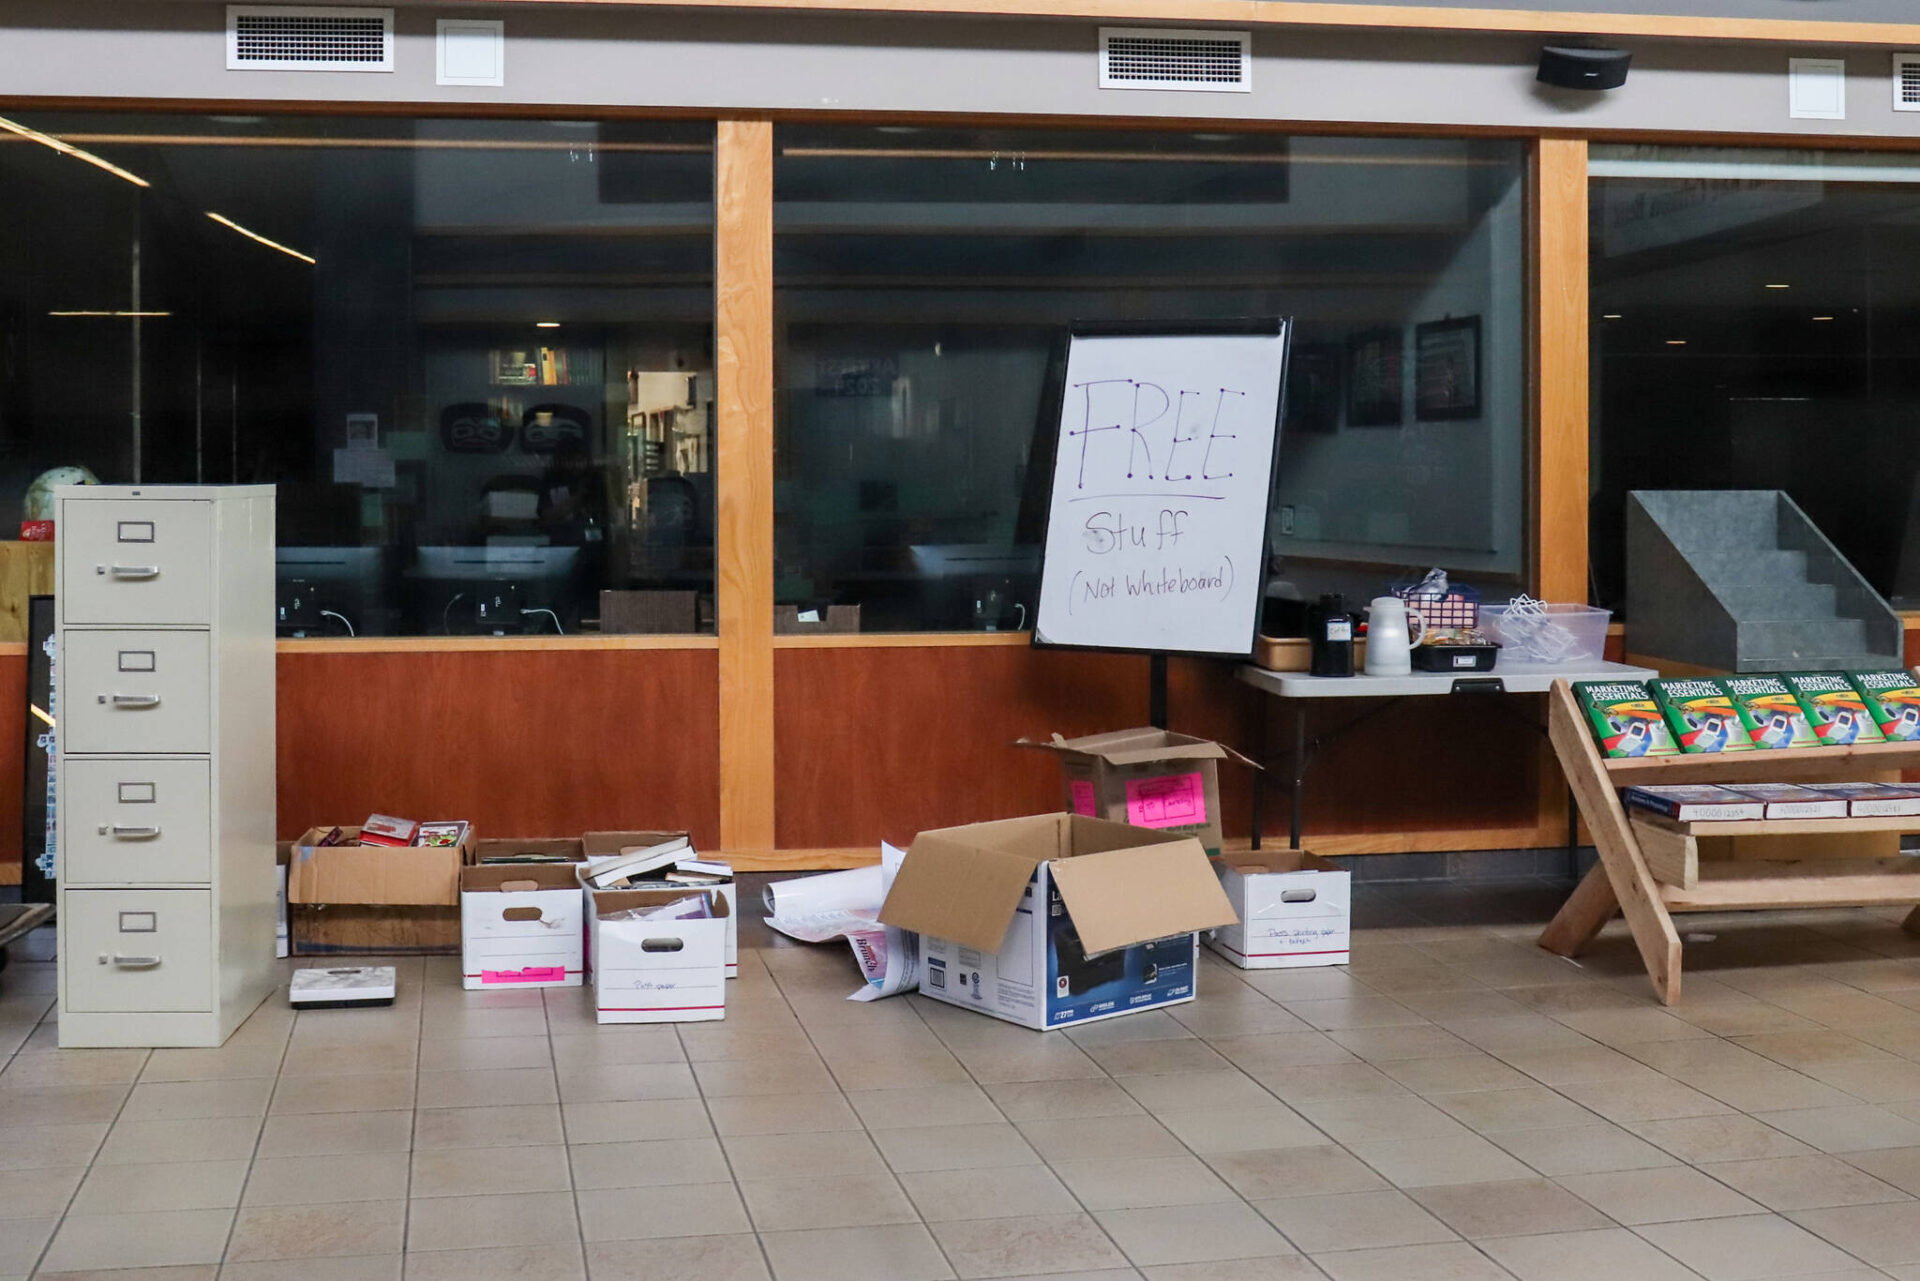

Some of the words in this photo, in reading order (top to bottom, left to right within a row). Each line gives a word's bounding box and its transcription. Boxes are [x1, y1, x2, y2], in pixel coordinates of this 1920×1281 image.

[1070, 379, 1245, 489] FREE
[1085, 509, 1188, 554] Stuff
[1069, 570, 1115, 615] (Not
[1126, 555, 1234, 602] Whiteboard)
[1791, 675, 1844, 685] MARKETING
[1856, 672, 1910, 682] MARKETING
[1660, 680, 1716, 690] MARKETING
[1725, 678, 1780, 688] MARKETING
[1799, 682, 1852, 692] ESSENTIALS
[1864, 679, 1917, 690] ESSENTIALS
[1585, 684, 1641, 694] MARKETING
[1667, 687, 1723, 697] ESSENTIALS
[1733, 685, 1788, 695] ESSENTIALS
[1591, 691, 1649, 701] ESSENTIALS
[856, 938, 878, 973] Brunch
